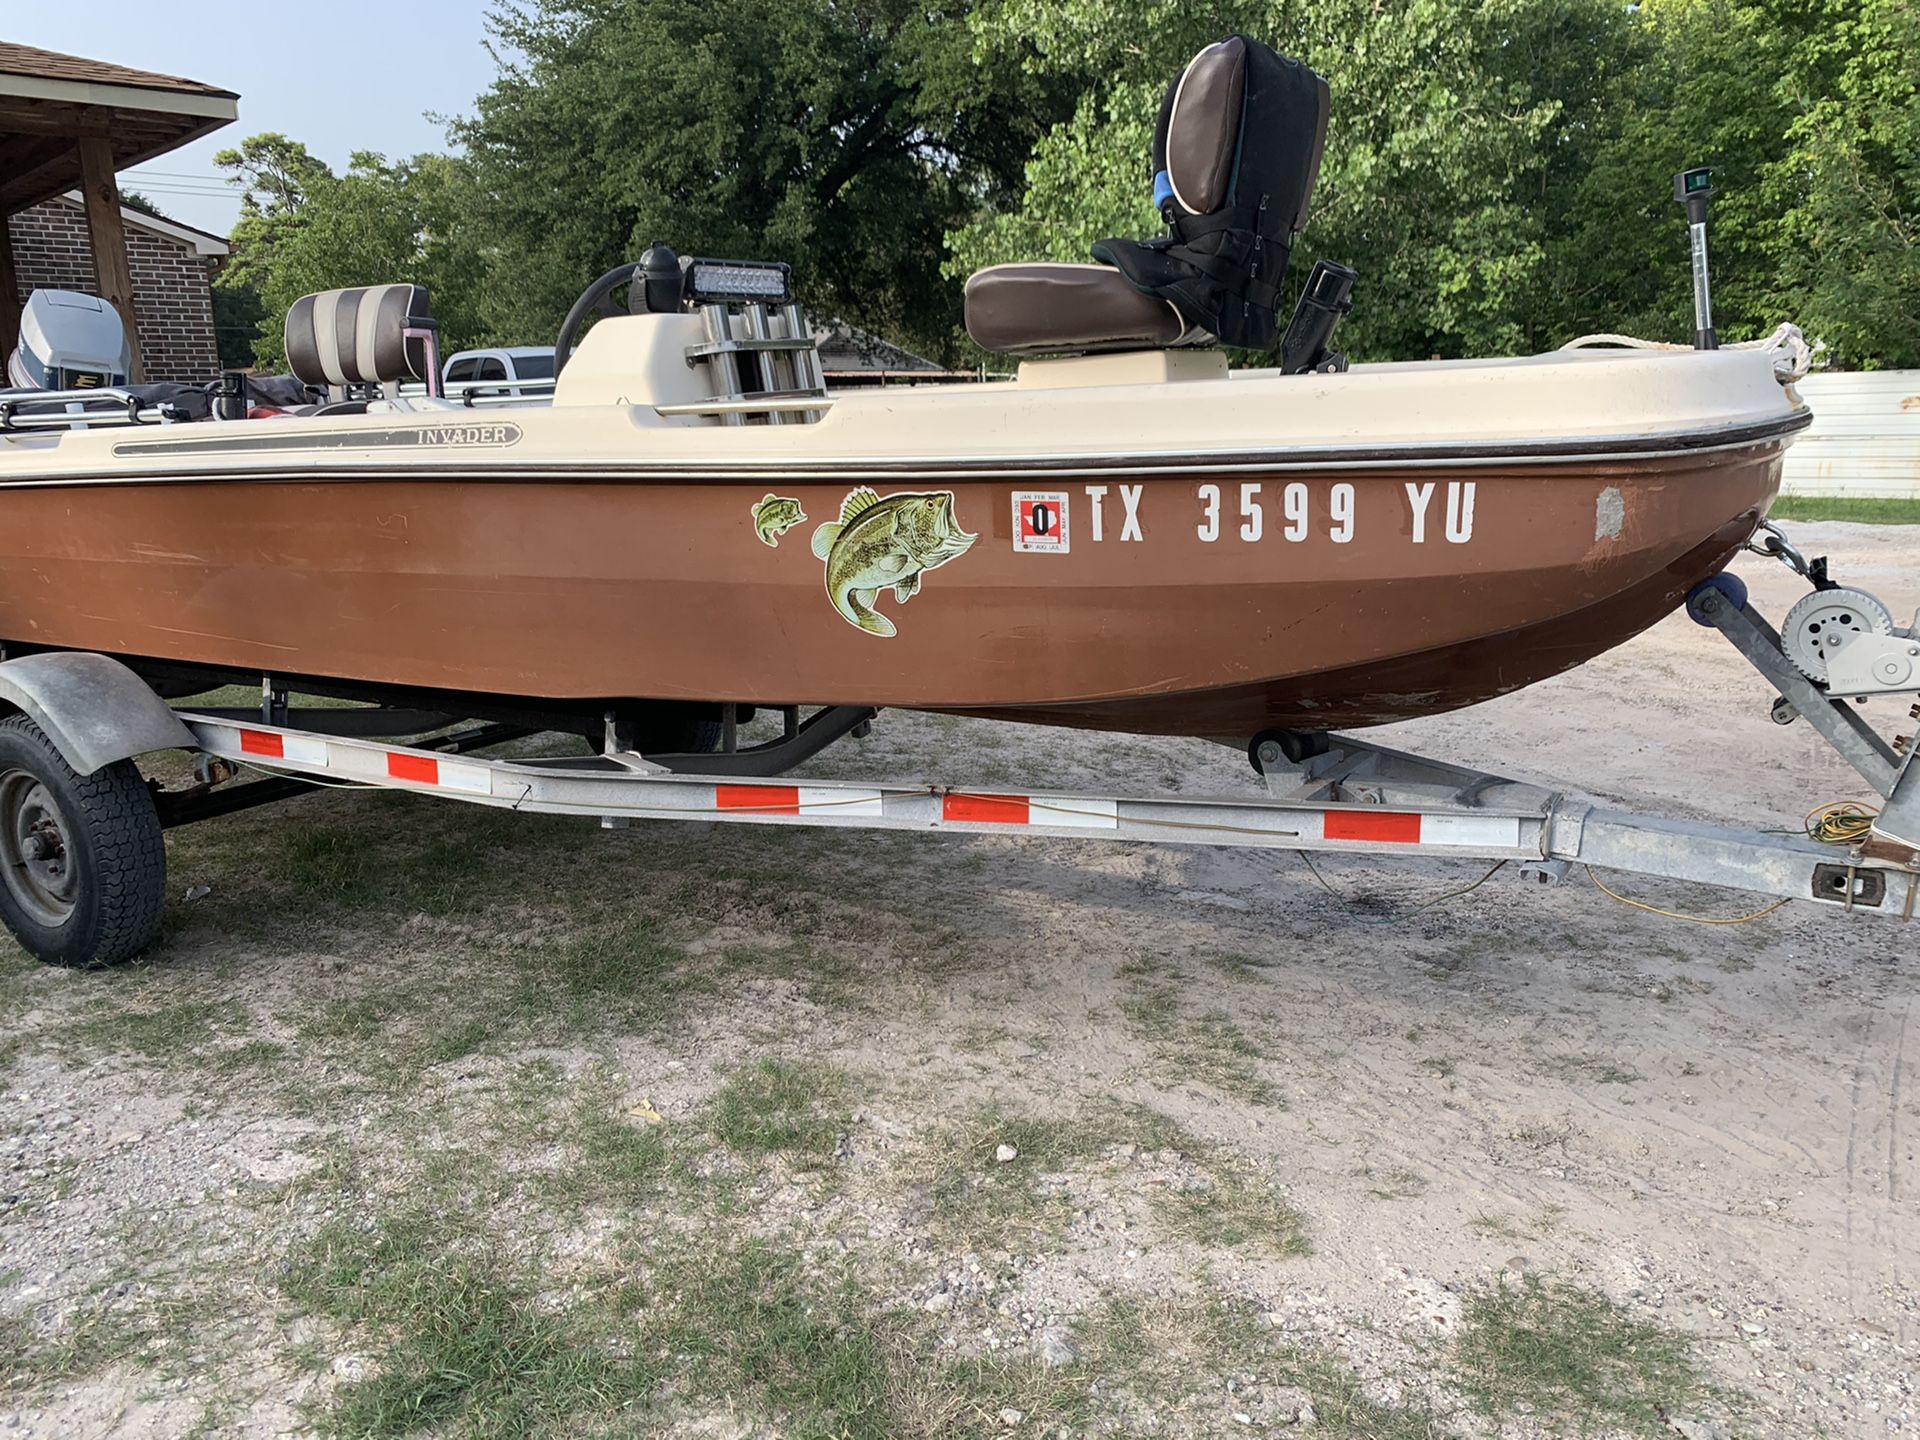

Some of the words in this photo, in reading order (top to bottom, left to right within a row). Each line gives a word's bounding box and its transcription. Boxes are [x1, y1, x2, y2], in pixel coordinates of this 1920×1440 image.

[417, 427, 507, 444] INVADER
[1032, 504, 1049, 536] 0
[1085, 485, 1143, 541] TX
[1197, 482, 1355, 543] 3599
[1405, 482, 1476, 543] YU
